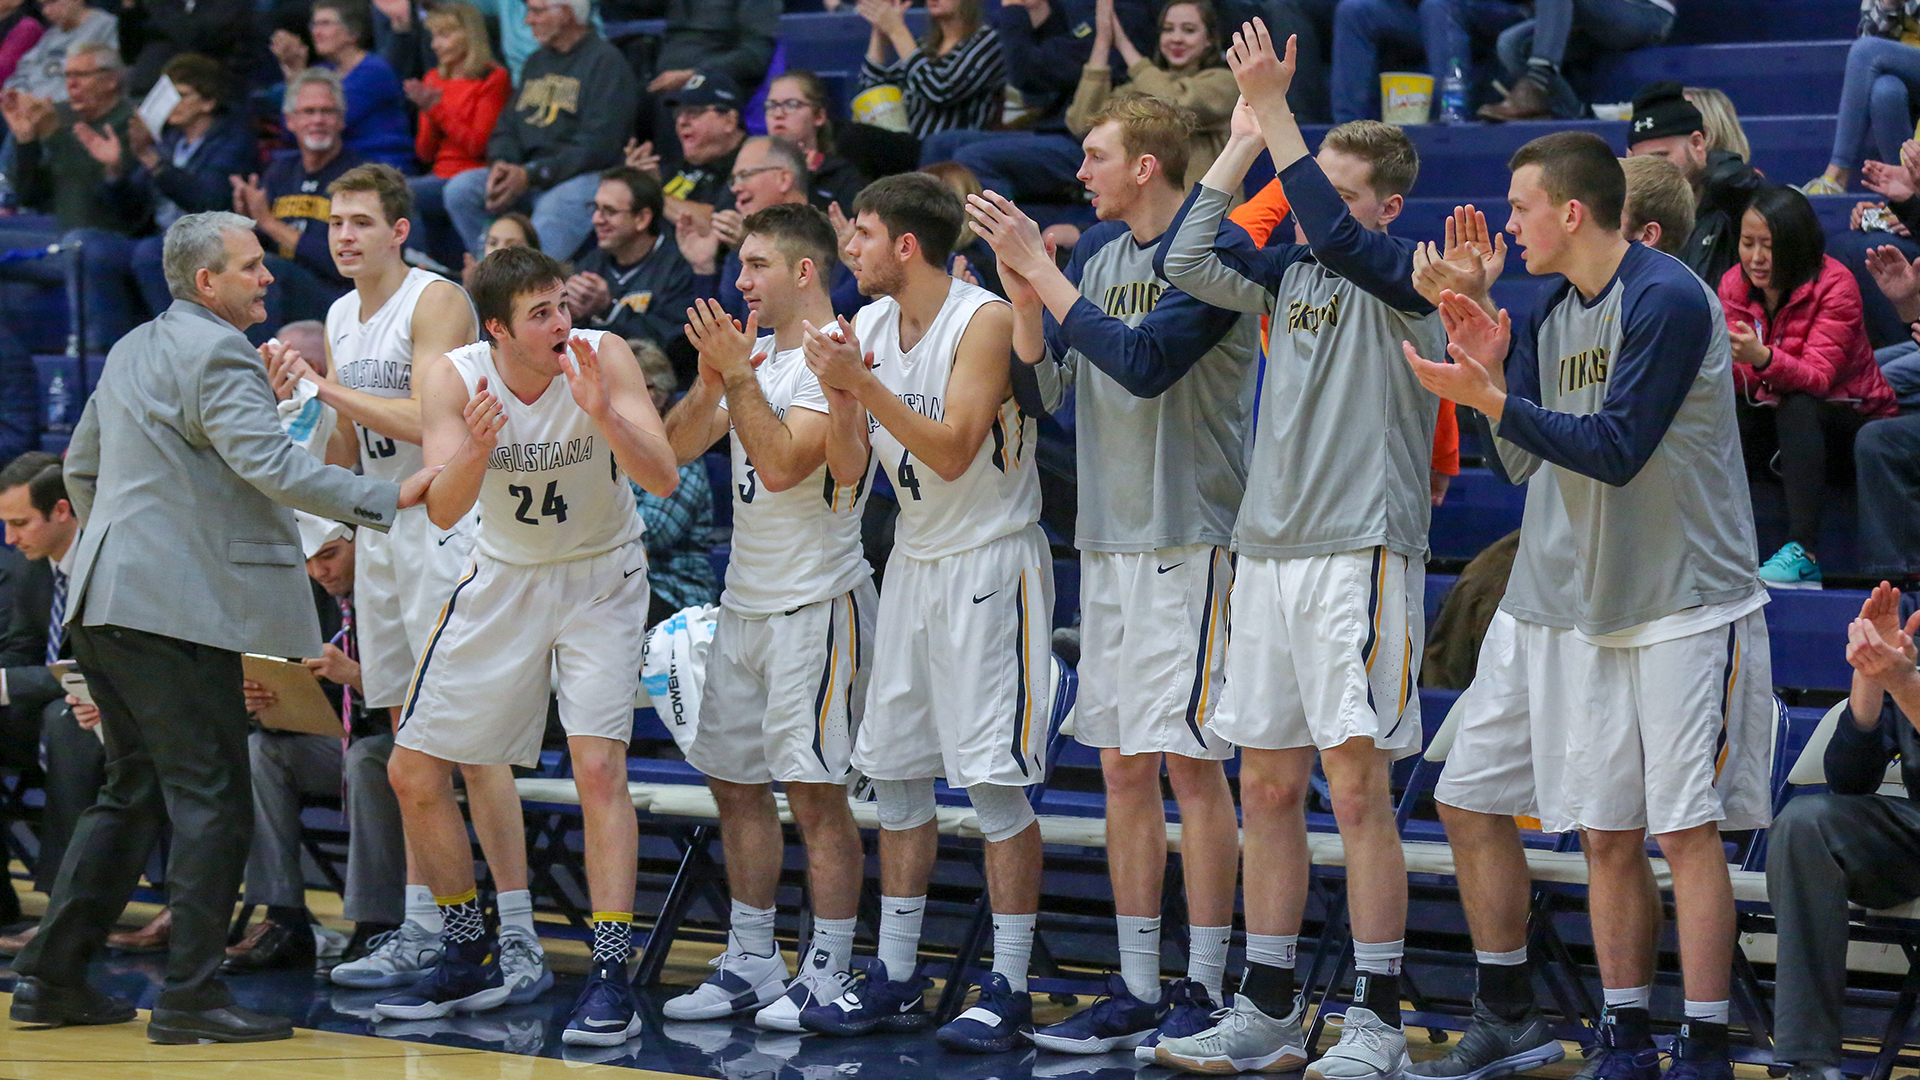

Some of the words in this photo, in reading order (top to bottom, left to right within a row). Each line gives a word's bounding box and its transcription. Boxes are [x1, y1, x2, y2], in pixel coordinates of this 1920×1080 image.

[487, 435, 594, 473] UGUSTANA
[898, 447, 922, 501] 4
[508, 479, 569, 526] 24
